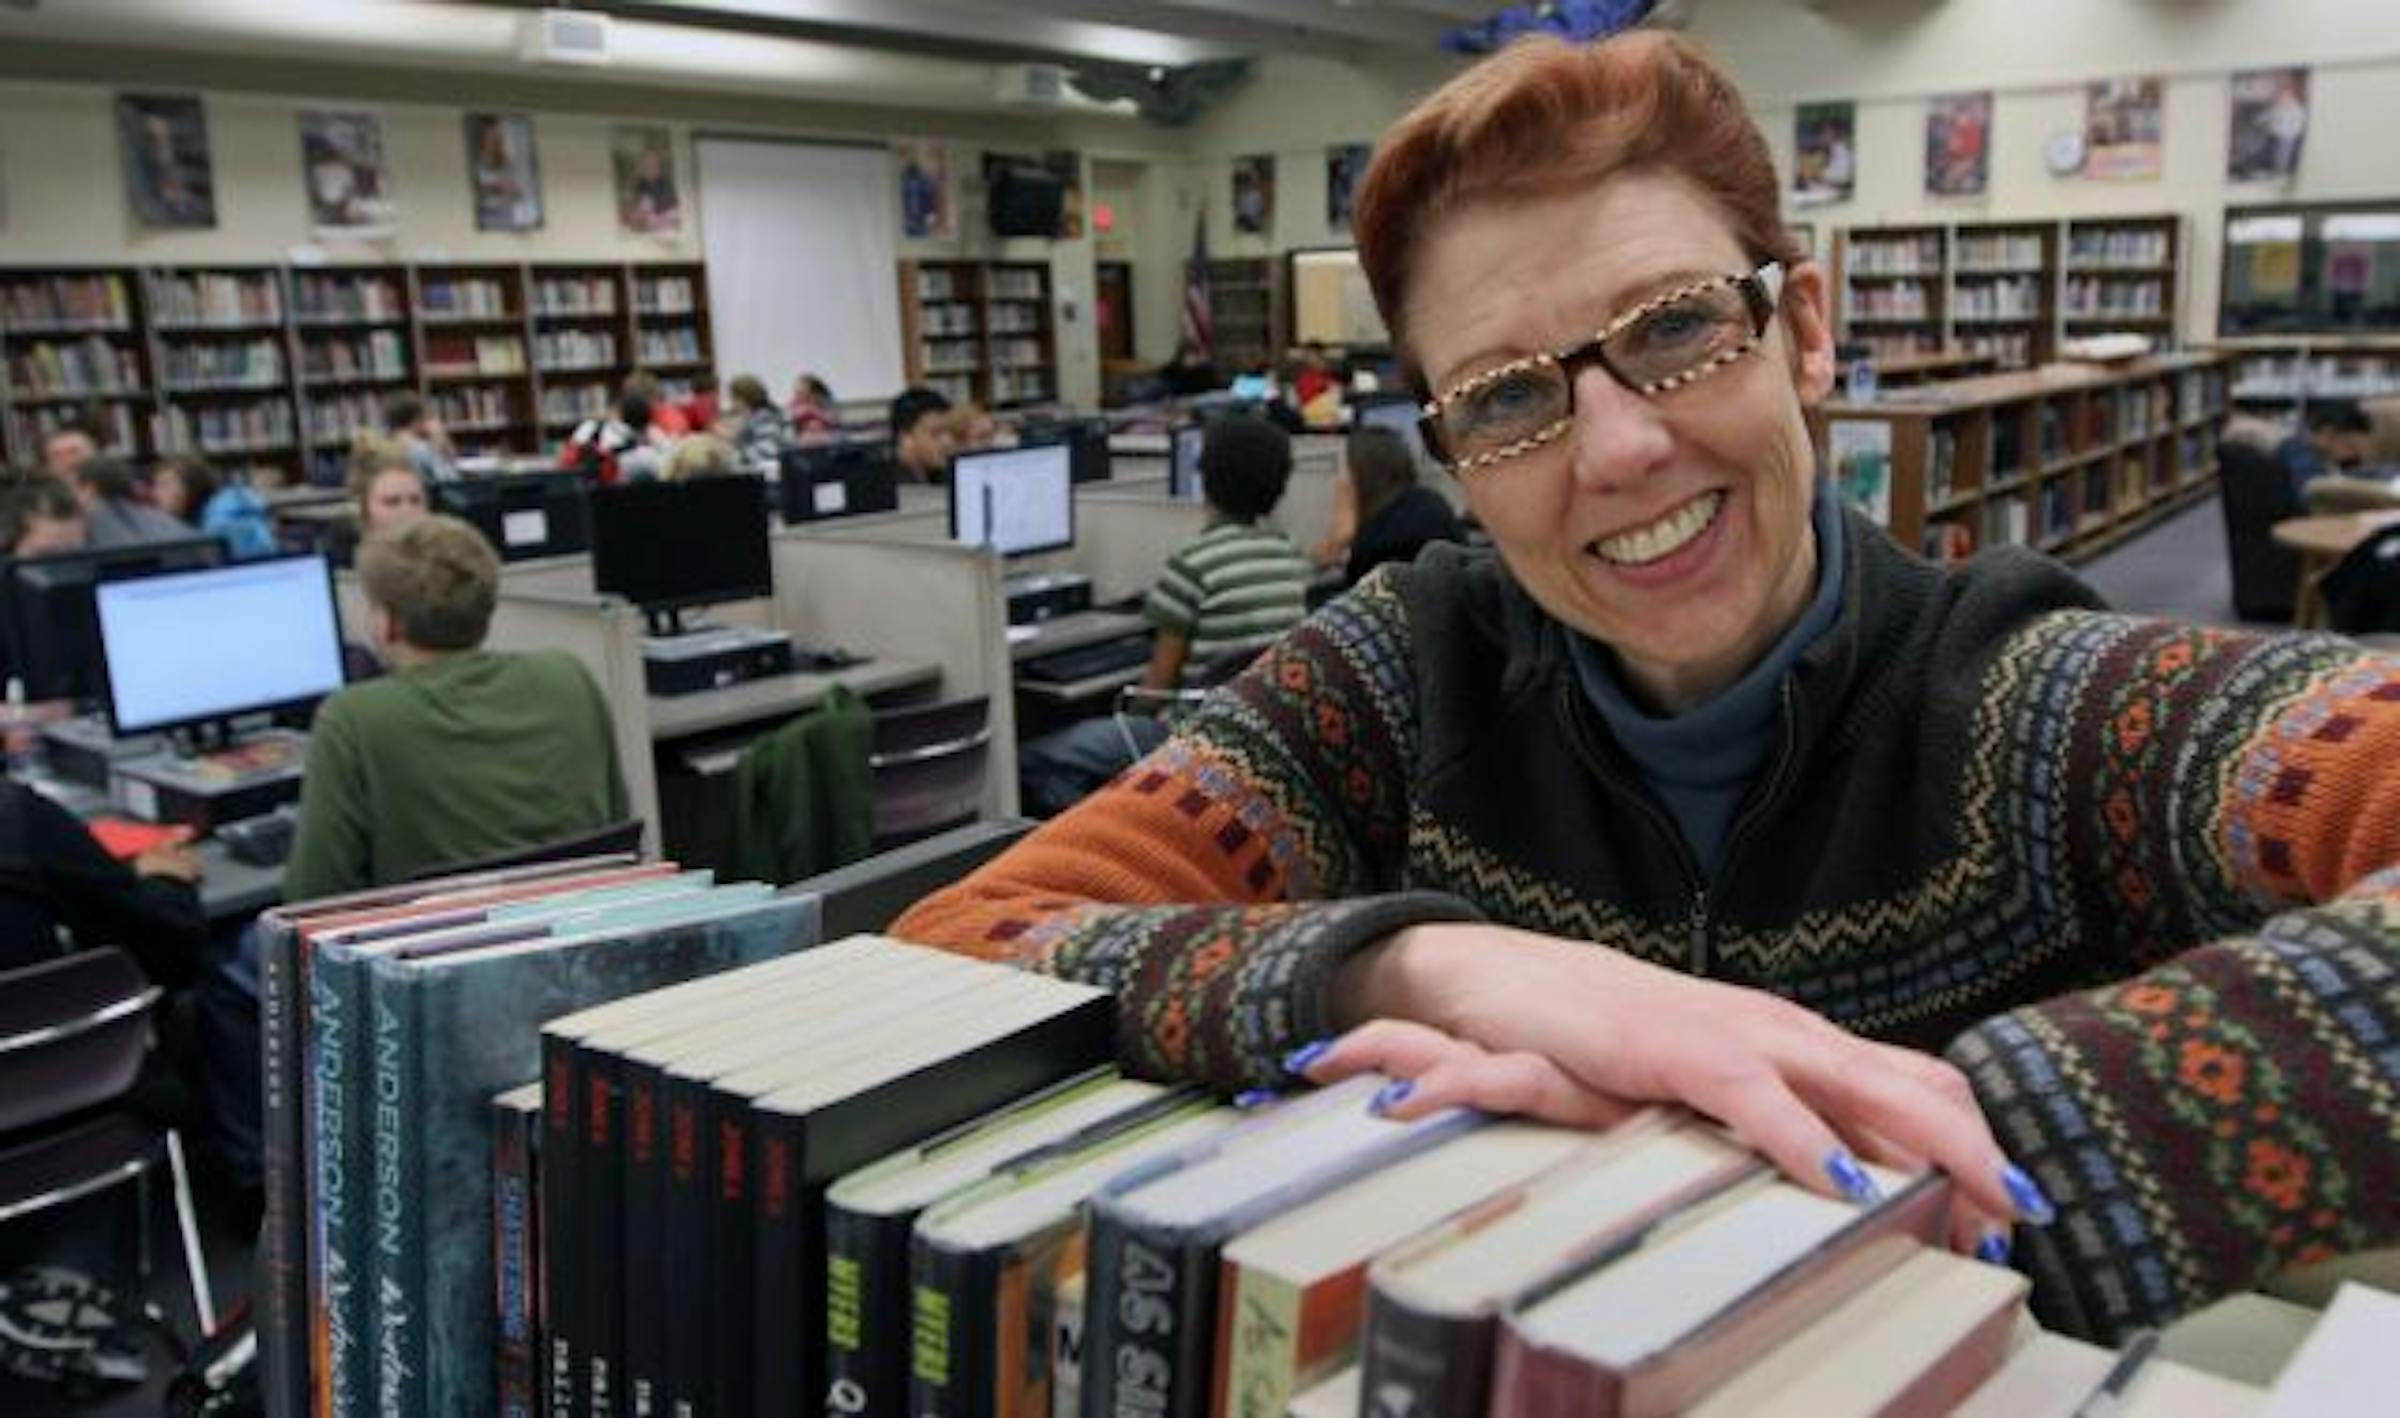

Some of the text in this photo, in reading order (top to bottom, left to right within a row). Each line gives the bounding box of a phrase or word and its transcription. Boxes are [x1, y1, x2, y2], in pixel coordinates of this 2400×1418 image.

[312, 979, 344, 1226] ANDERSON
[374, 1005, 403, 1255] ANDERSON
[1119, 1242, 1176, 1335] AS
